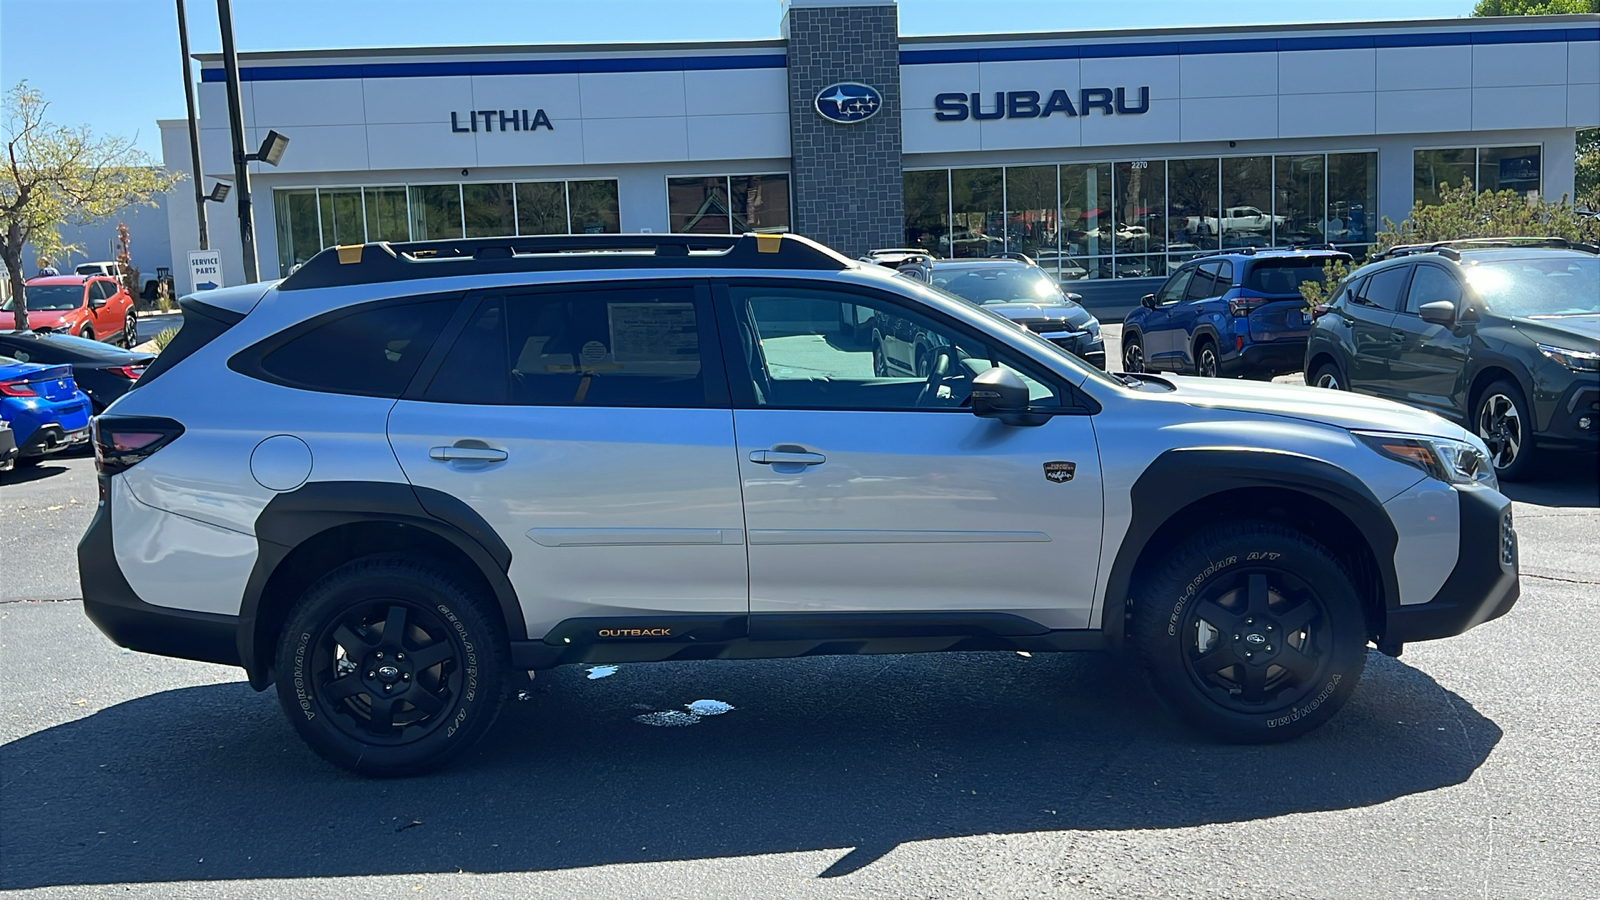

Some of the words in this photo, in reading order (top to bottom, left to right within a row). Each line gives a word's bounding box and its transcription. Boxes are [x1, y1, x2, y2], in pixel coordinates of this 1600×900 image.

[934, 86, 1150, 121] SUBARU
[450, 109, 554, 133] LITHIA
[1131, 161, 1148, 169] 2270
[191, 257, 218, 266] SERVICE
[195, 267, 217, 275] PARTS
[1167, 555, 1238, 637] GEOLANDAR
[1246, 551, 1281, 561] A/T
[598, 628, 671, 637] OUTBACK
[437, 604, 478, 702] GEOLANDAR
[294, 632, 316, 721] YOKOHAMA
[1266, 673, 1342, 728] YOKOHAMA
[447, 708, 467, 738] A/T
